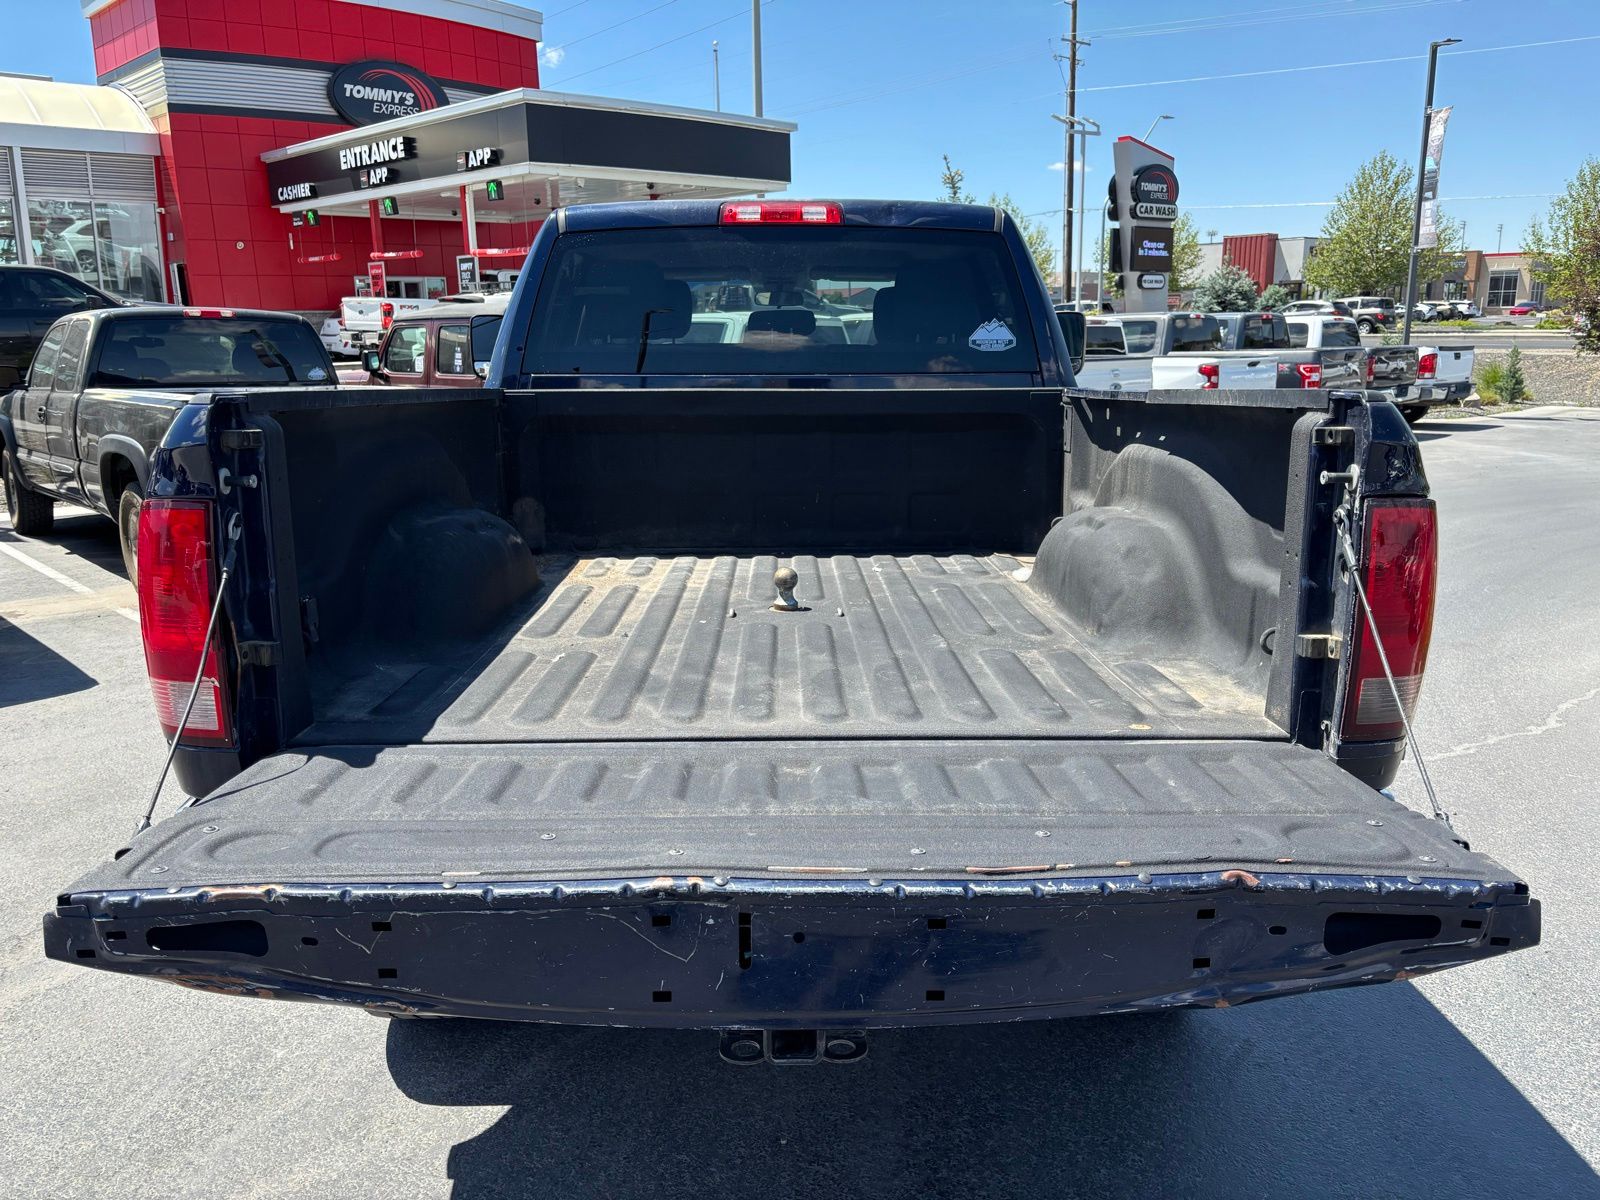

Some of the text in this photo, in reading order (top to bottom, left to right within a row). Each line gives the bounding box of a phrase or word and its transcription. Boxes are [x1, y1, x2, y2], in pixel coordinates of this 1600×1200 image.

[344, 83, 415, 106] TOMMY'S
[373, 102, 420, 117] EXPRESS
[339, 136, 405, 170] ENTRANCE
[468, 147, 491, 168] APP
[369, 166, 388, 185] APP
[277, 183, 312, 202] CASHIER
[1141, 182, 1168, 193] TOMMY'S
[1150, 192, 1168, 200] EXPRESS
[1139, 204, 1176, 217] CAR WASH
